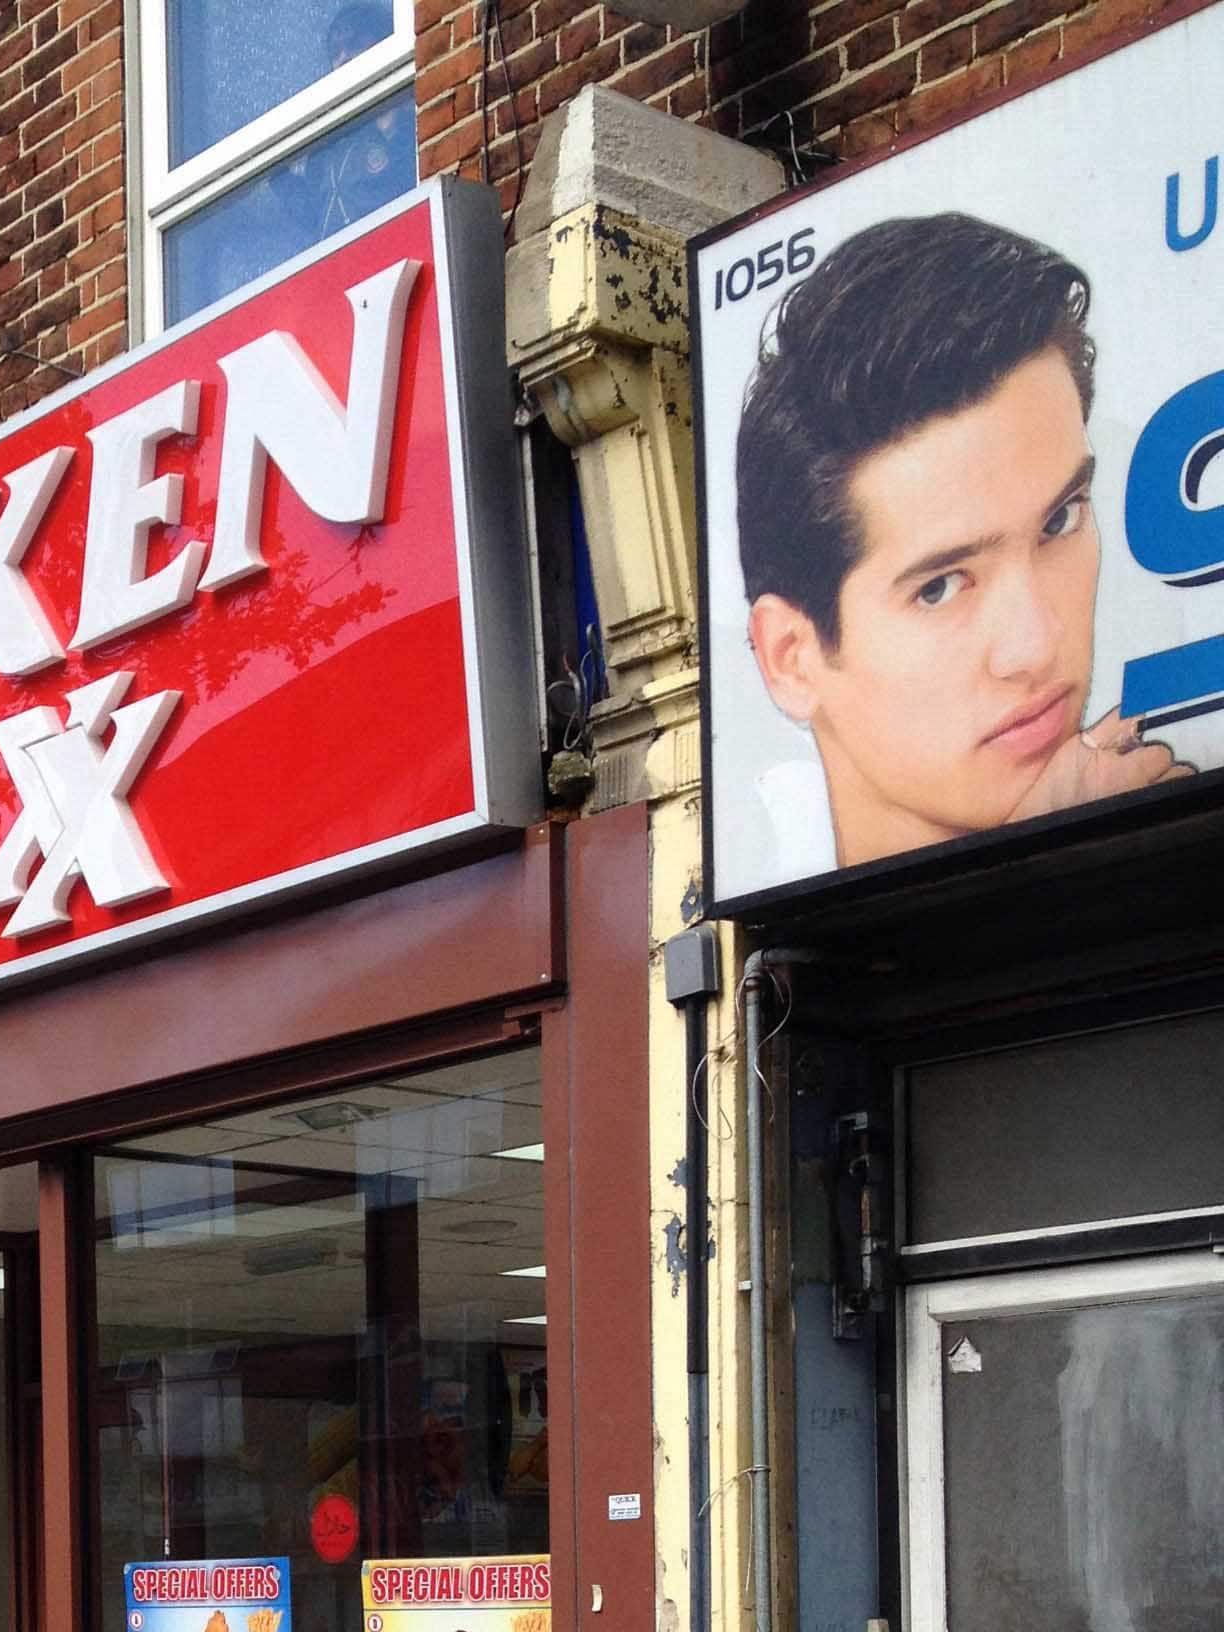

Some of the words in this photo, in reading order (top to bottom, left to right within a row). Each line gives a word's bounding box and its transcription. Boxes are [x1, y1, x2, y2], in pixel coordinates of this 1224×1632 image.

[714, 226, 816, 311] 1056
[133, 1568, 209, 1601] SPECIAL
[212, 1565, 281, 1600] OFFERS
[372, 1567, 465, 1603] SPECIAL
[468, 1563, 551, 1601] OFFERS
